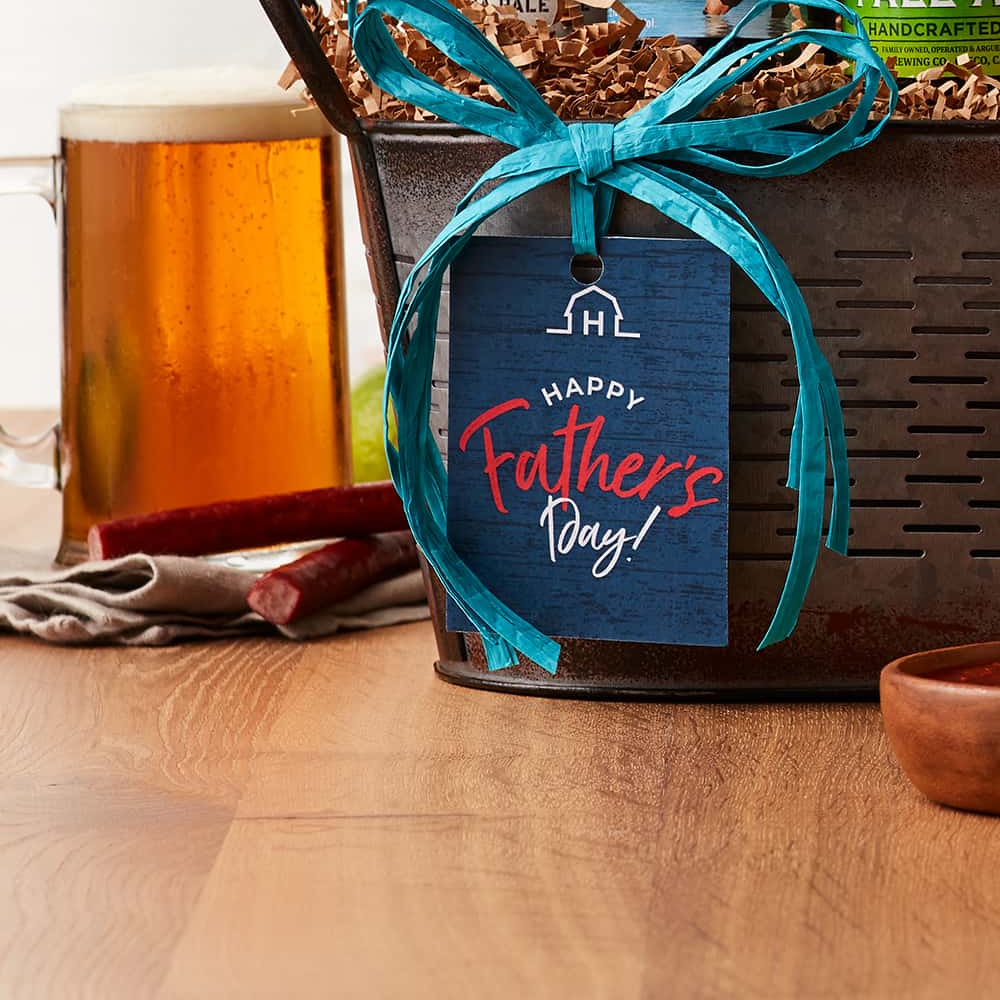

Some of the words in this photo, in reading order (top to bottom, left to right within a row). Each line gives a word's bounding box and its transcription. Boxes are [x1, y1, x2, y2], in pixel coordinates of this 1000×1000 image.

[541, 376, 645, 411] HAPPY
[459, 398, 723, 518] Father's
[540, 495, 661, 578] Day!
